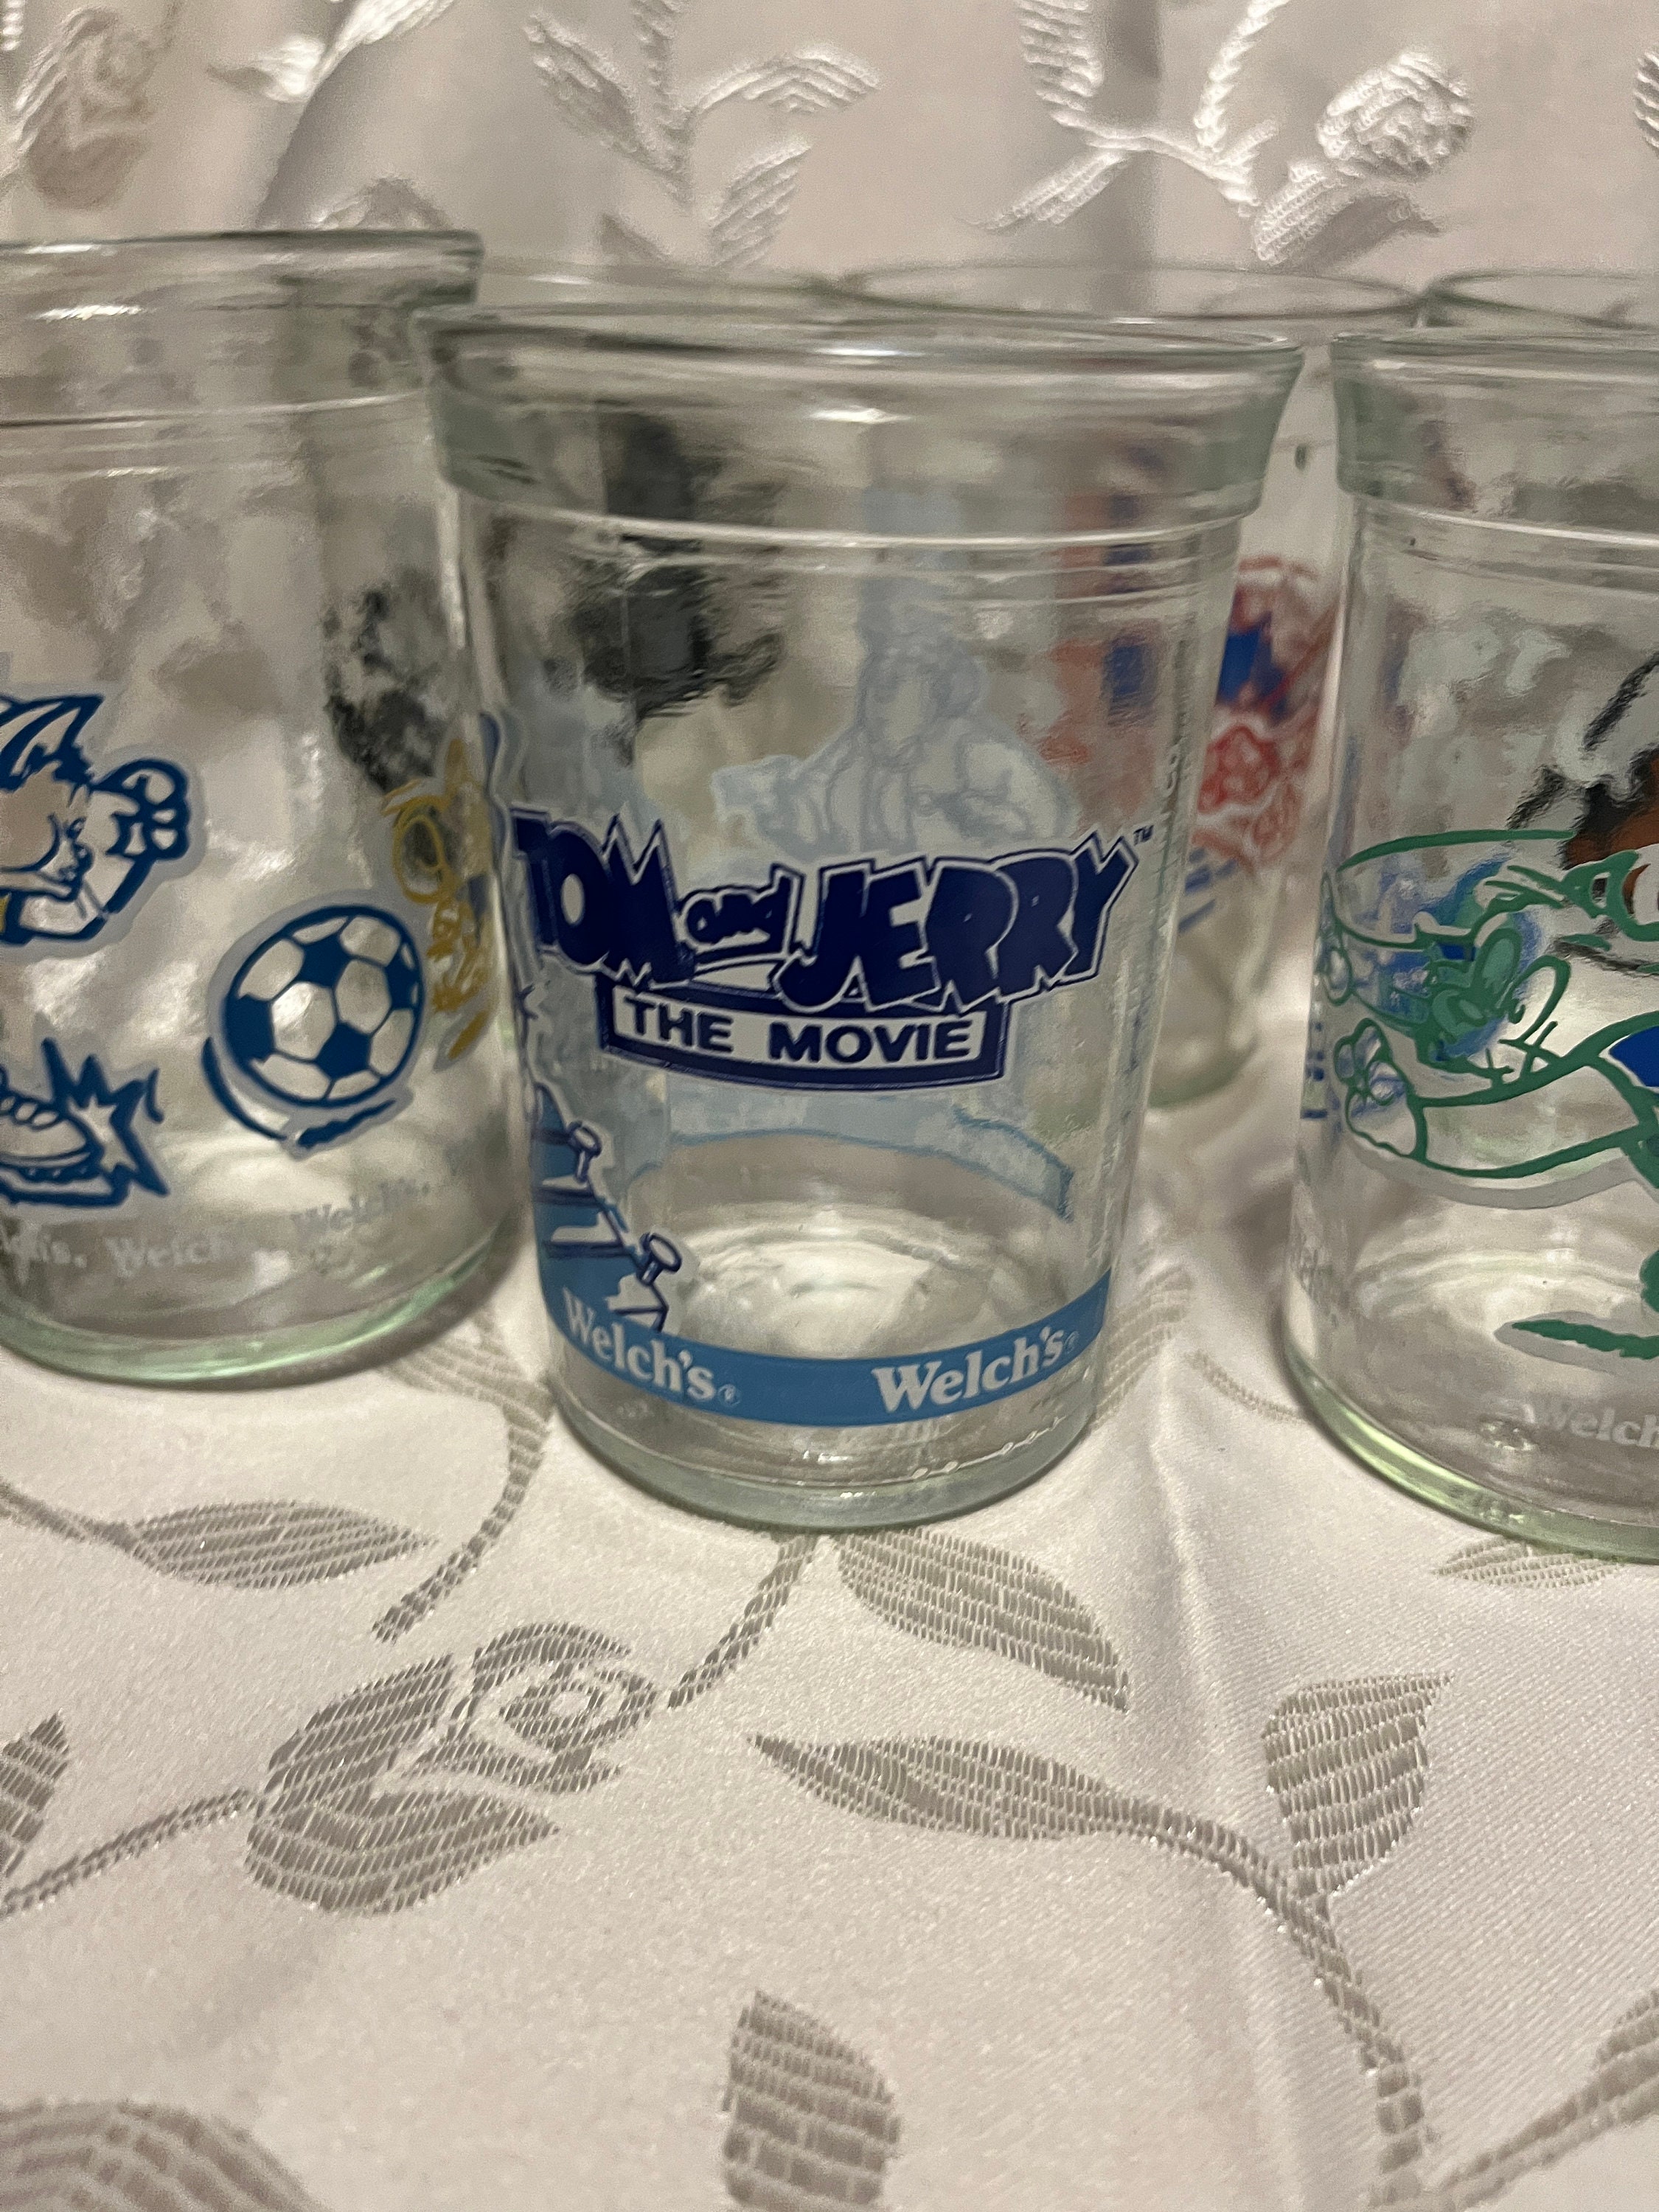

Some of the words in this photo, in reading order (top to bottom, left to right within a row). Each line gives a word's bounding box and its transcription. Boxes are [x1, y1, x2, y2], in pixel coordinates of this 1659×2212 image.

[510, 810, 695, 988] TOM
[682, 865, 804, 953] and
[771, 831, 1138, 1013] JERRY
[624, 997, 733, 1051] THE
[768, 1019, 976, 1065] MOVIE
